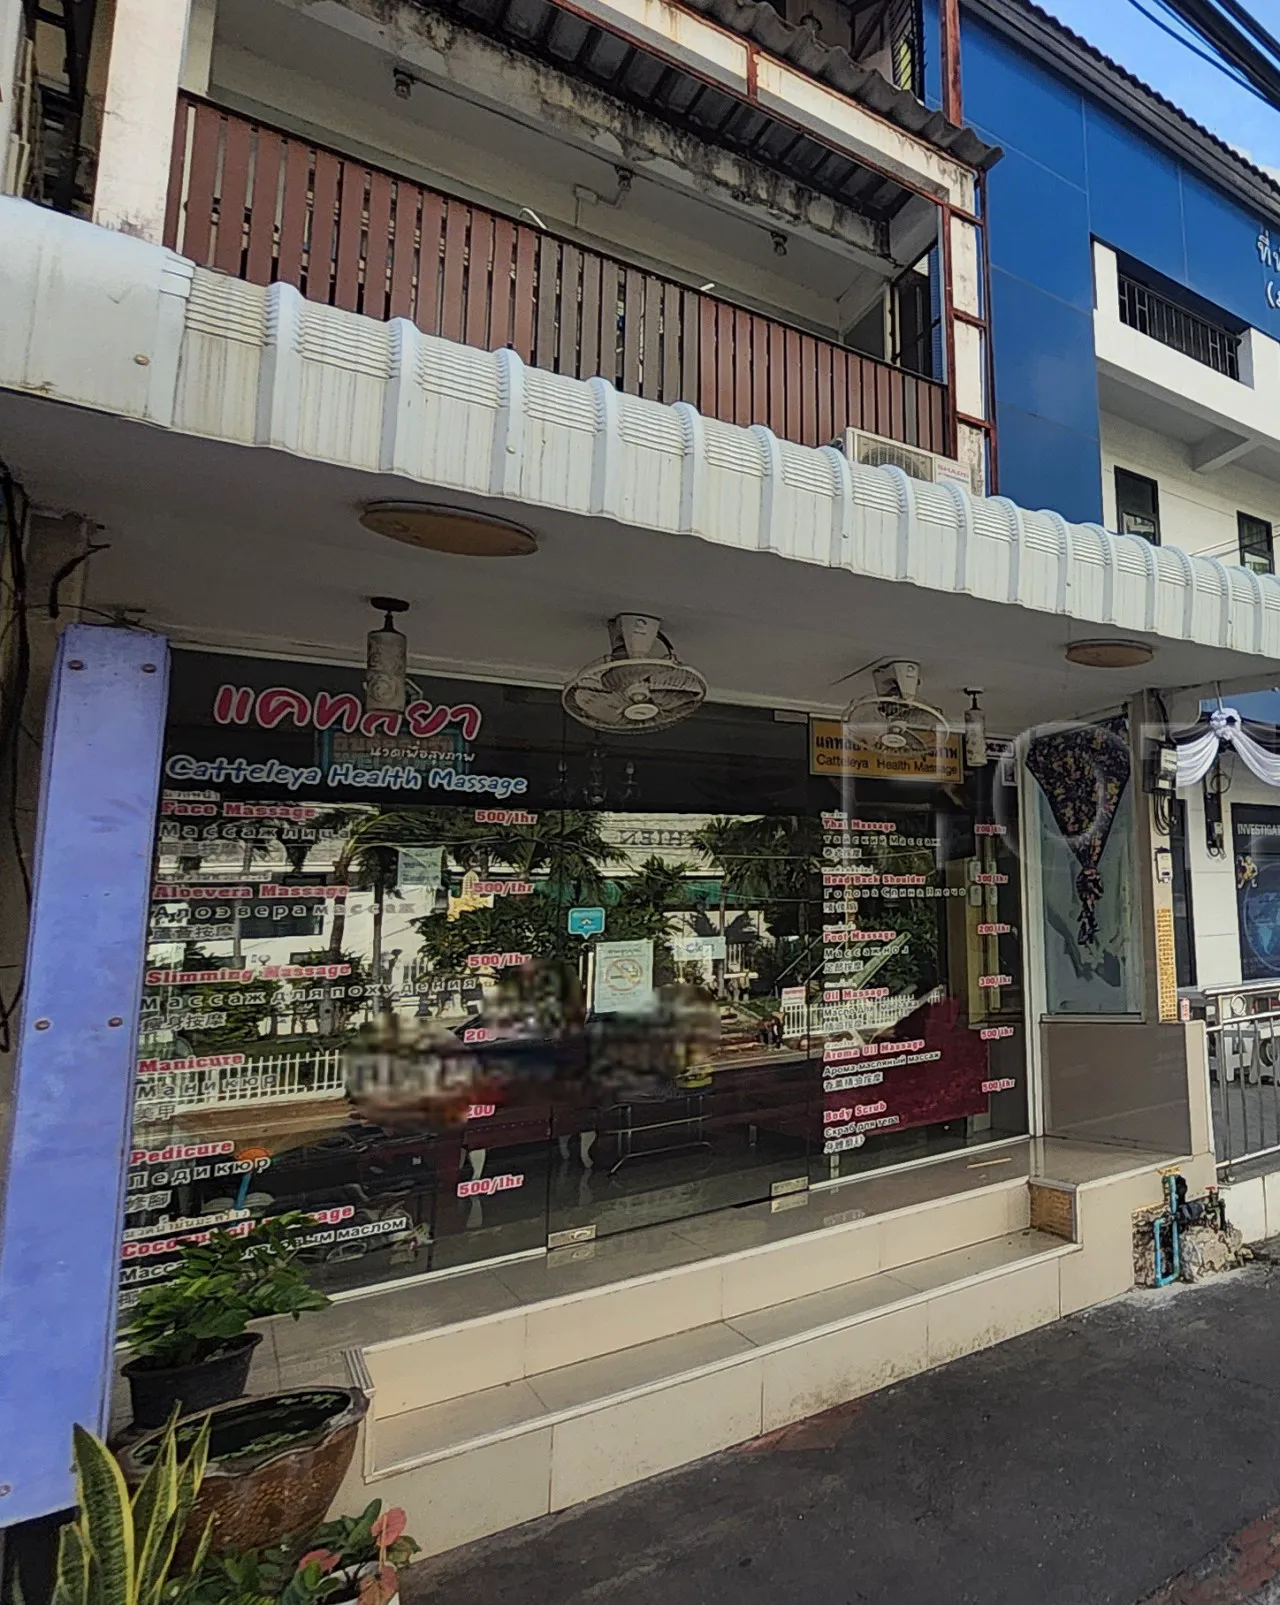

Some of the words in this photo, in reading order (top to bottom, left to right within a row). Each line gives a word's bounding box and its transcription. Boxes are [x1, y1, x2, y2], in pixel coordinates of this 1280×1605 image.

[877, 759, 911, 772] Health
[914, 762, 958, 776] Massage
[165, 755, 320, 790] Catteleya
[328, 763, 420, 790] Health
[428, 767, 528, 798] Massage
[161, 801, 217, 816] Face
[223, 802, 319, 821] Massage
[852, 820, 896, 831] Massage
[854, 874, 880, 885] Back
[882, 874, 926, 886] Shoulder
[153, 885, 253, 900] Aloevera
[259, 884, 349, 899] Massage
[850, 931, 896, 943] Massage
[145, 967, 254, 986] Slimming
[262, 963, 353, 982] Massage
[842, 987, 890, 1001] Massage
[464, 1028, 496, 1043] 20
[880, 1039, 926, 1055] Massage
[138, 1052, 245, 1075] Manicure
[823, 1107, 853, 1125] Body
[854, 1100, 887, 1118] Scrub
[130, 1140, 234, 1166] Pedicure
[336, 1217, 407, 1242] маслом
